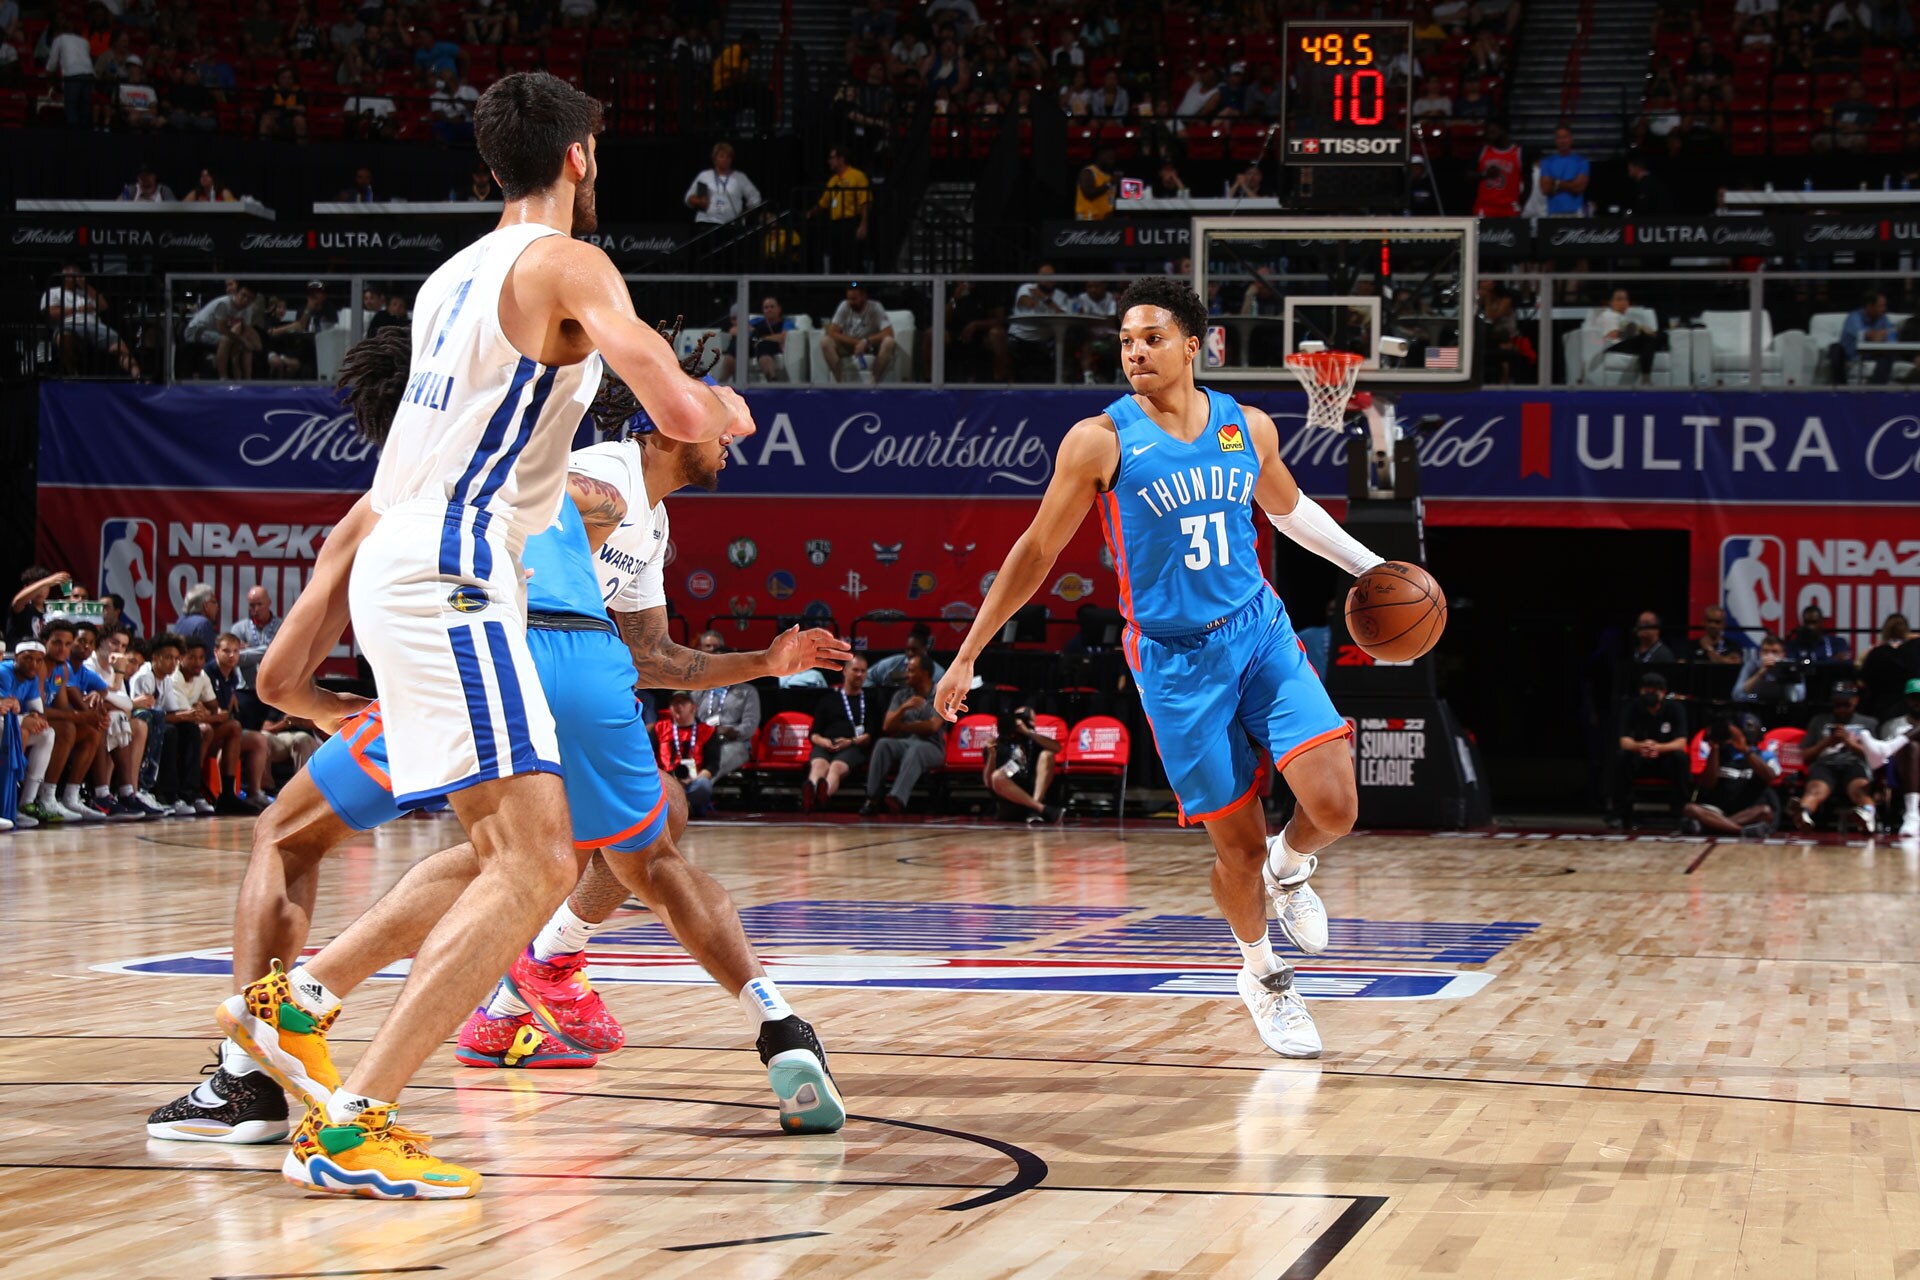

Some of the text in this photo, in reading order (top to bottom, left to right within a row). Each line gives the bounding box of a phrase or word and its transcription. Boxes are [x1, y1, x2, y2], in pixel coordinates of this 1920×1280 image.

[1301, 33, 1373, 66] 49.5
[1333, 69, 1385, 126] 10
[1319, 138, 1402, 154] TISSOT
[12, 226, 215, 252] Michelob ULTRA Courtside
[240, 232, 444, 252] Michelob ULTRA Courtside
[620, 235, 676, 254] Courtside
[1054, 229, 1122, 247] Michelob
[1550, 224, 1776, 246] Michelob ULTRA Courtside
[1803, 222, 1878, 243] Michelob
[829, 411, 1051, 486] Courtside
[1577, 413, 1840, 472] ULTRA
[1136, 465, 1255, 518] THUNDER
[1179, 511, 1230, 571] 31
[1361, 731, 1426, 759] SUMMER
[1361, 760, 1415, 786] LEAGUE
[299, 984, 324, 1004] adidas
